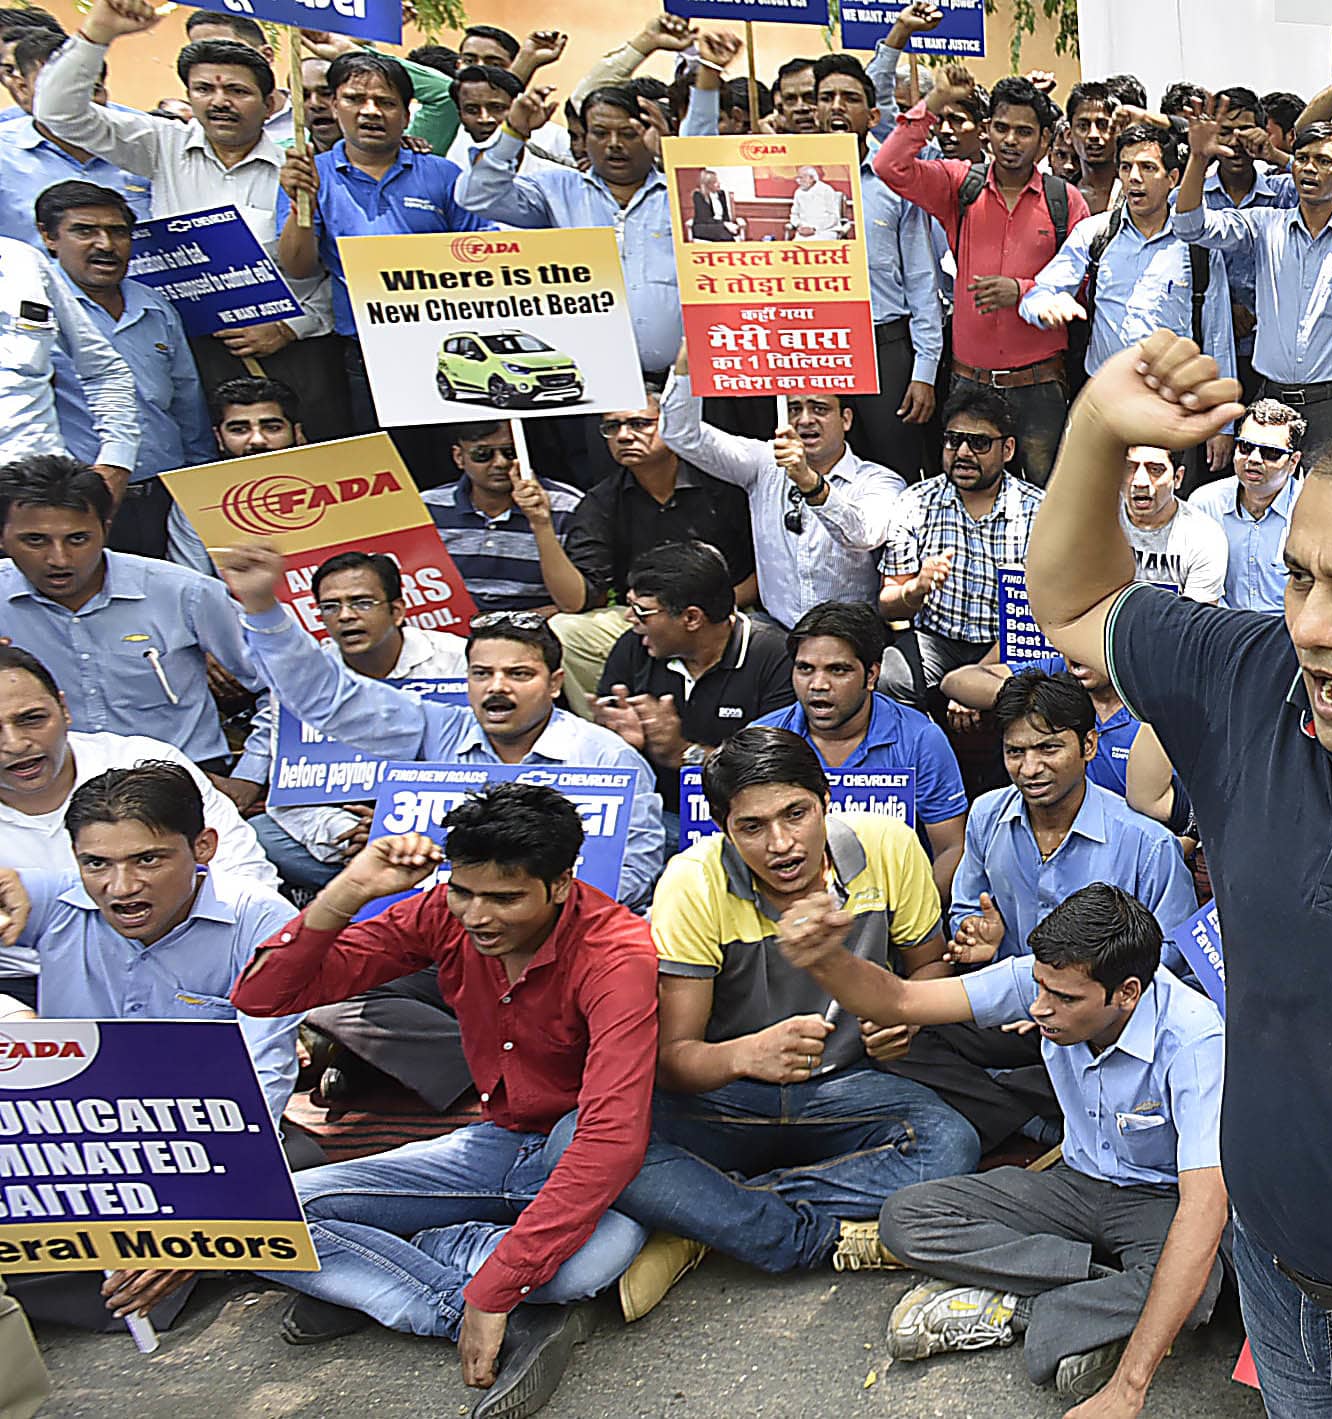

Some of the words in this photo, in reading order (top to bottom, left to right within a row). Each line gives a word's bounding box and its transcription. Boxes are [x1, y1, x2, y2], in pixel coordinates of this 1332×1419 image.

[910, 36, 925, 48] WE
[924, 38, 947, 49] WANT
[948, 39, 981, 52] JUSTICE
[751, 145, 787, 155] FADA
[471, 242, 521, 255] FADA
[692, 251, 773, 267] जनरल
[782, 244, 851, 266] मोटर्स
[380, 267, 494, 291] Where
[502, 265, 531, 287] is
[538, 264, 592, 284] the
[696, 275, 721, 294] ने
[725, 273, 785, 296] तोड़ा
[792, 276, 852, 292] वादा
[366, 301, 420, 325] New
[426, 295, 544, 321] Chevrolet
[547, 291, 615, 316] Beat?
[780, 308, 814, 320] गया
[708, 324, 771, 350] मैरी
[777, 328, 852, 350] बारा
[711, 356, 743, 370] का
[748, 355, 760, 370] 1
[766, 352, 853, 370] बिलियन
[713, 374, 772, 390] निवेश
[776, 376, 805, 389] का
[809, 375, 855, 389] वादा
[275, 471, 403, 515] FADA
[1133, 548, 1182, 571] MANI
[278, 756, 326, 789] before
[325, 754, 378, 794] paying
[387, 769, 419, 782] FIND
[419, 770, 450, 783] NEW
[450, 772, 489, 784] ROADS
[557, 774, 632, 788] CHEVROLET
[843, 774, 909, 787] CHEVROLET
[869, 795, 907, 822] India
[0, 1098, 261, 1136] UNICATED.
[0, 1140, 227, 1178] MINATED.
[0, 1231, 99, 1263] eral
[110, 1230, 298, 1260] Motors
